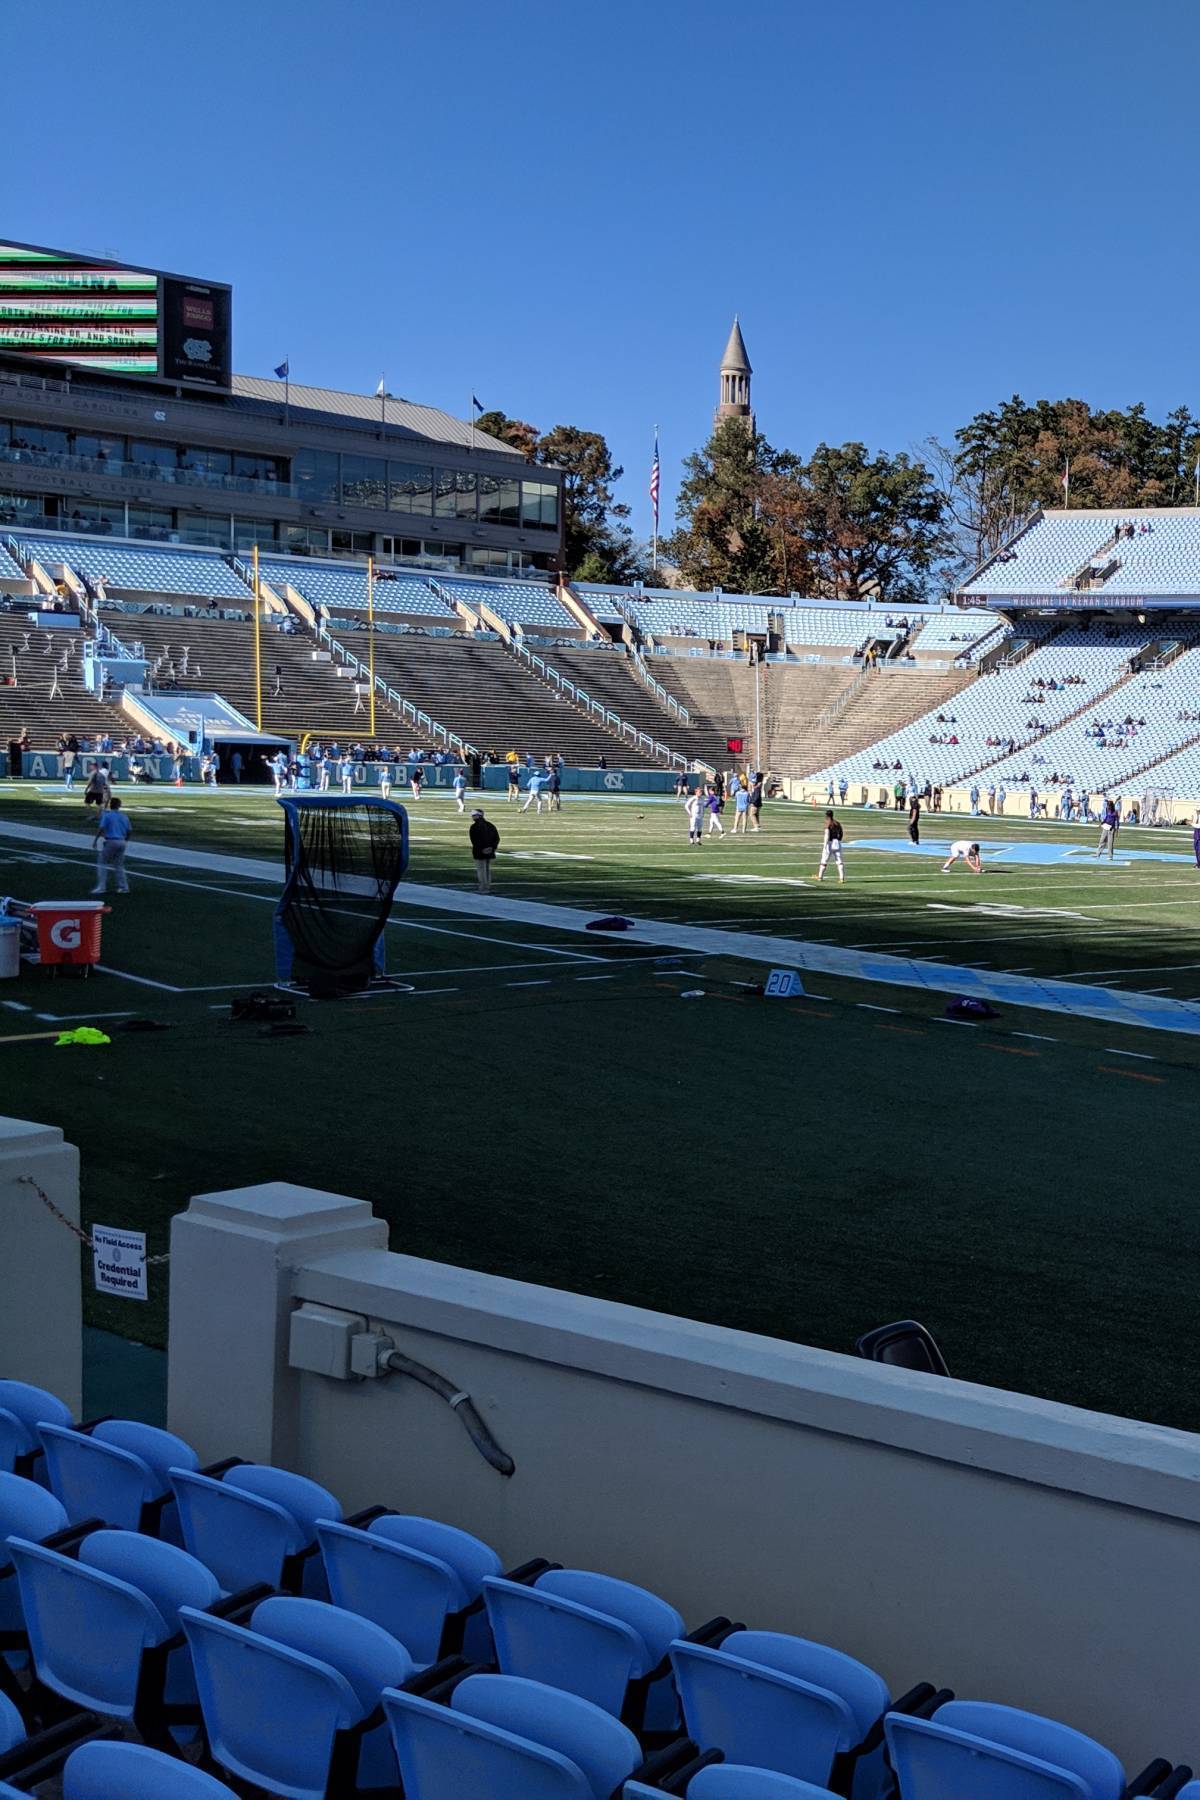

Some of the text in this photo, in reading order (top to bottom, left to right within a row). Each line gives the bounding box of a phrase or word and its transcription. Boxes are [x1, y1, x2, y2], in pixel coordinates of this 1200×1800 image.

[962, 595, 982, 606] 1:45
[1012, 597, 1144, 607] WELCOME TO KENAN STADIUM
[50, 918, 81, 949] G
[767, 973, 793, 994] 20
[98, 1260, 141, 1277] Credential
[101, 1272, 138, 1288] Required
